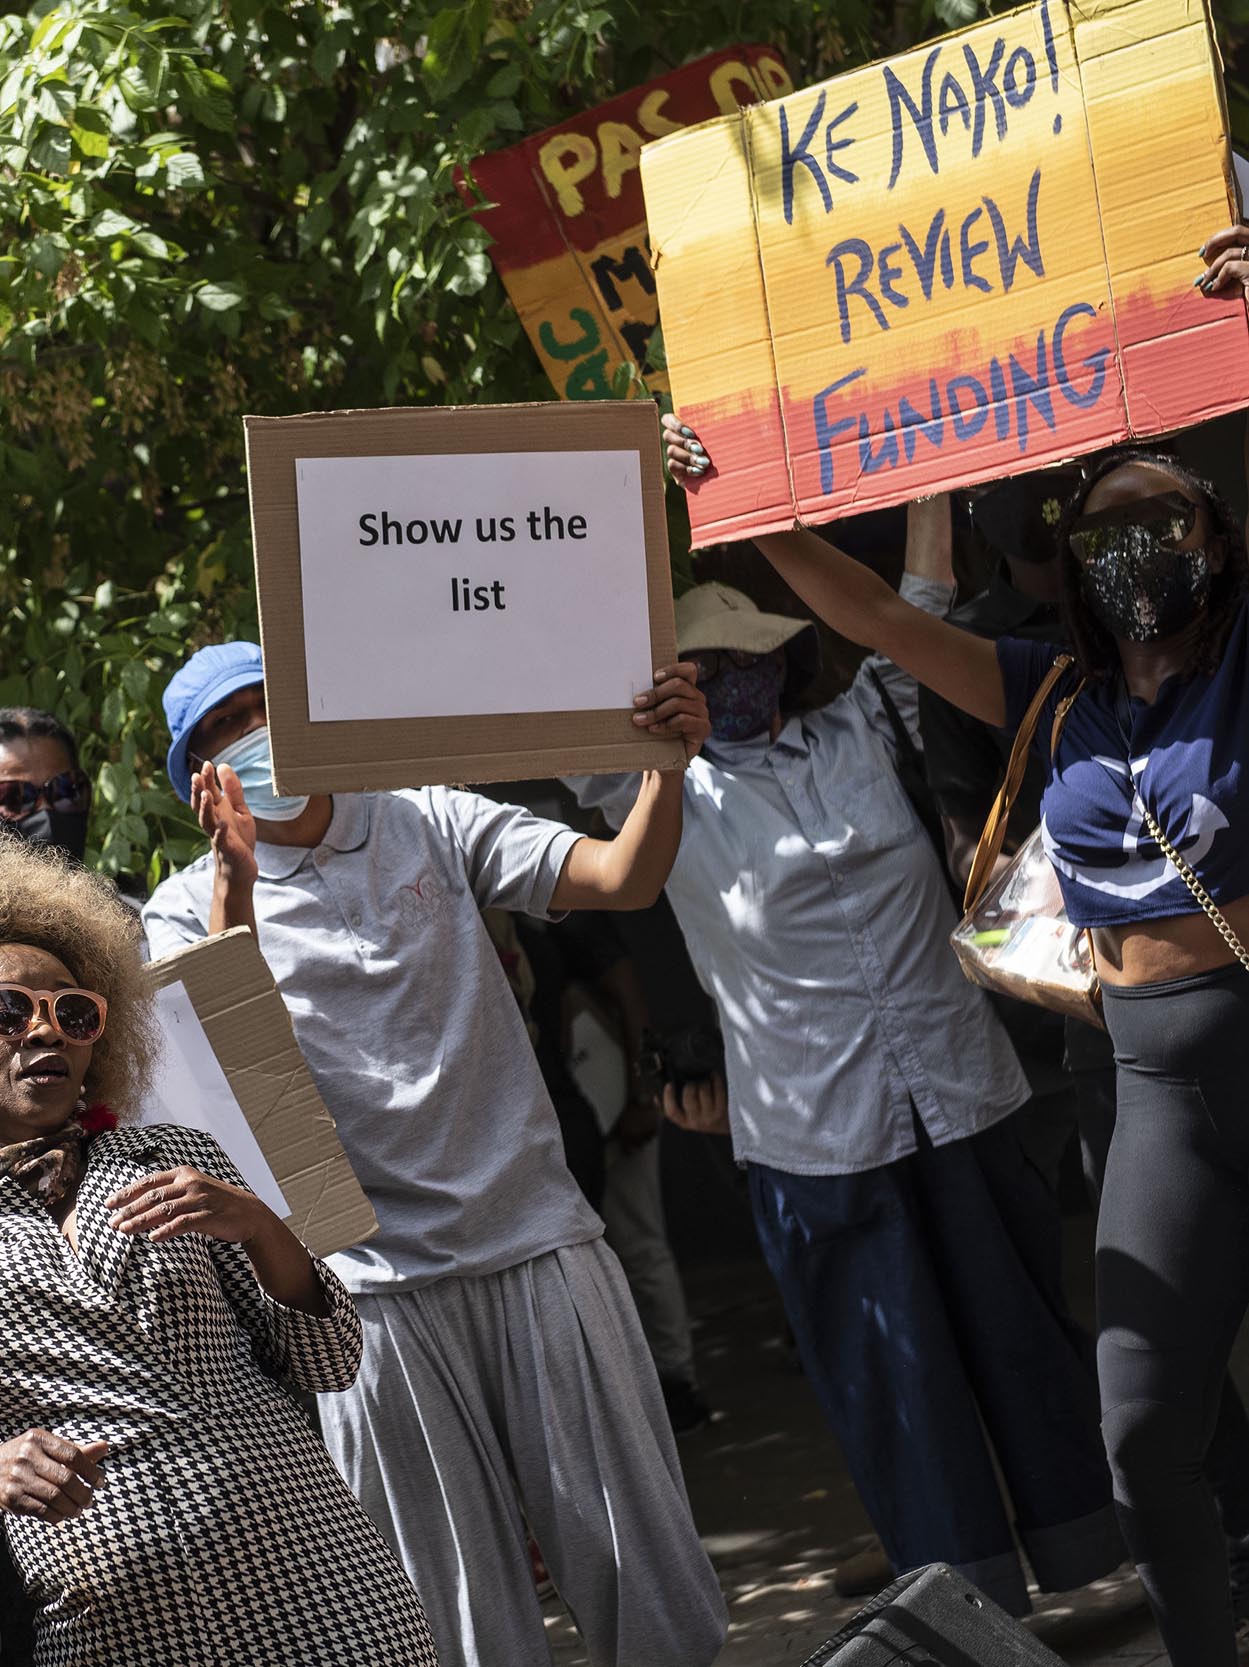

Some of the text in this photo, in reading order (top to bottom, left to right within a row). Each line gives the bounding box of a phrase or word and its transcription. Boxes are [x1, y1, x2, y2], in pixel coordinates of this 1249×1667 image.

[779, 0, 1063, 225] KE NAKO!
[825, 166, 1045, 344] REVIEW
[812, 302, 1113, 496] FUNDING
[358, 506, 587, 546] Show us the
[451, 577, 506, 611] list
